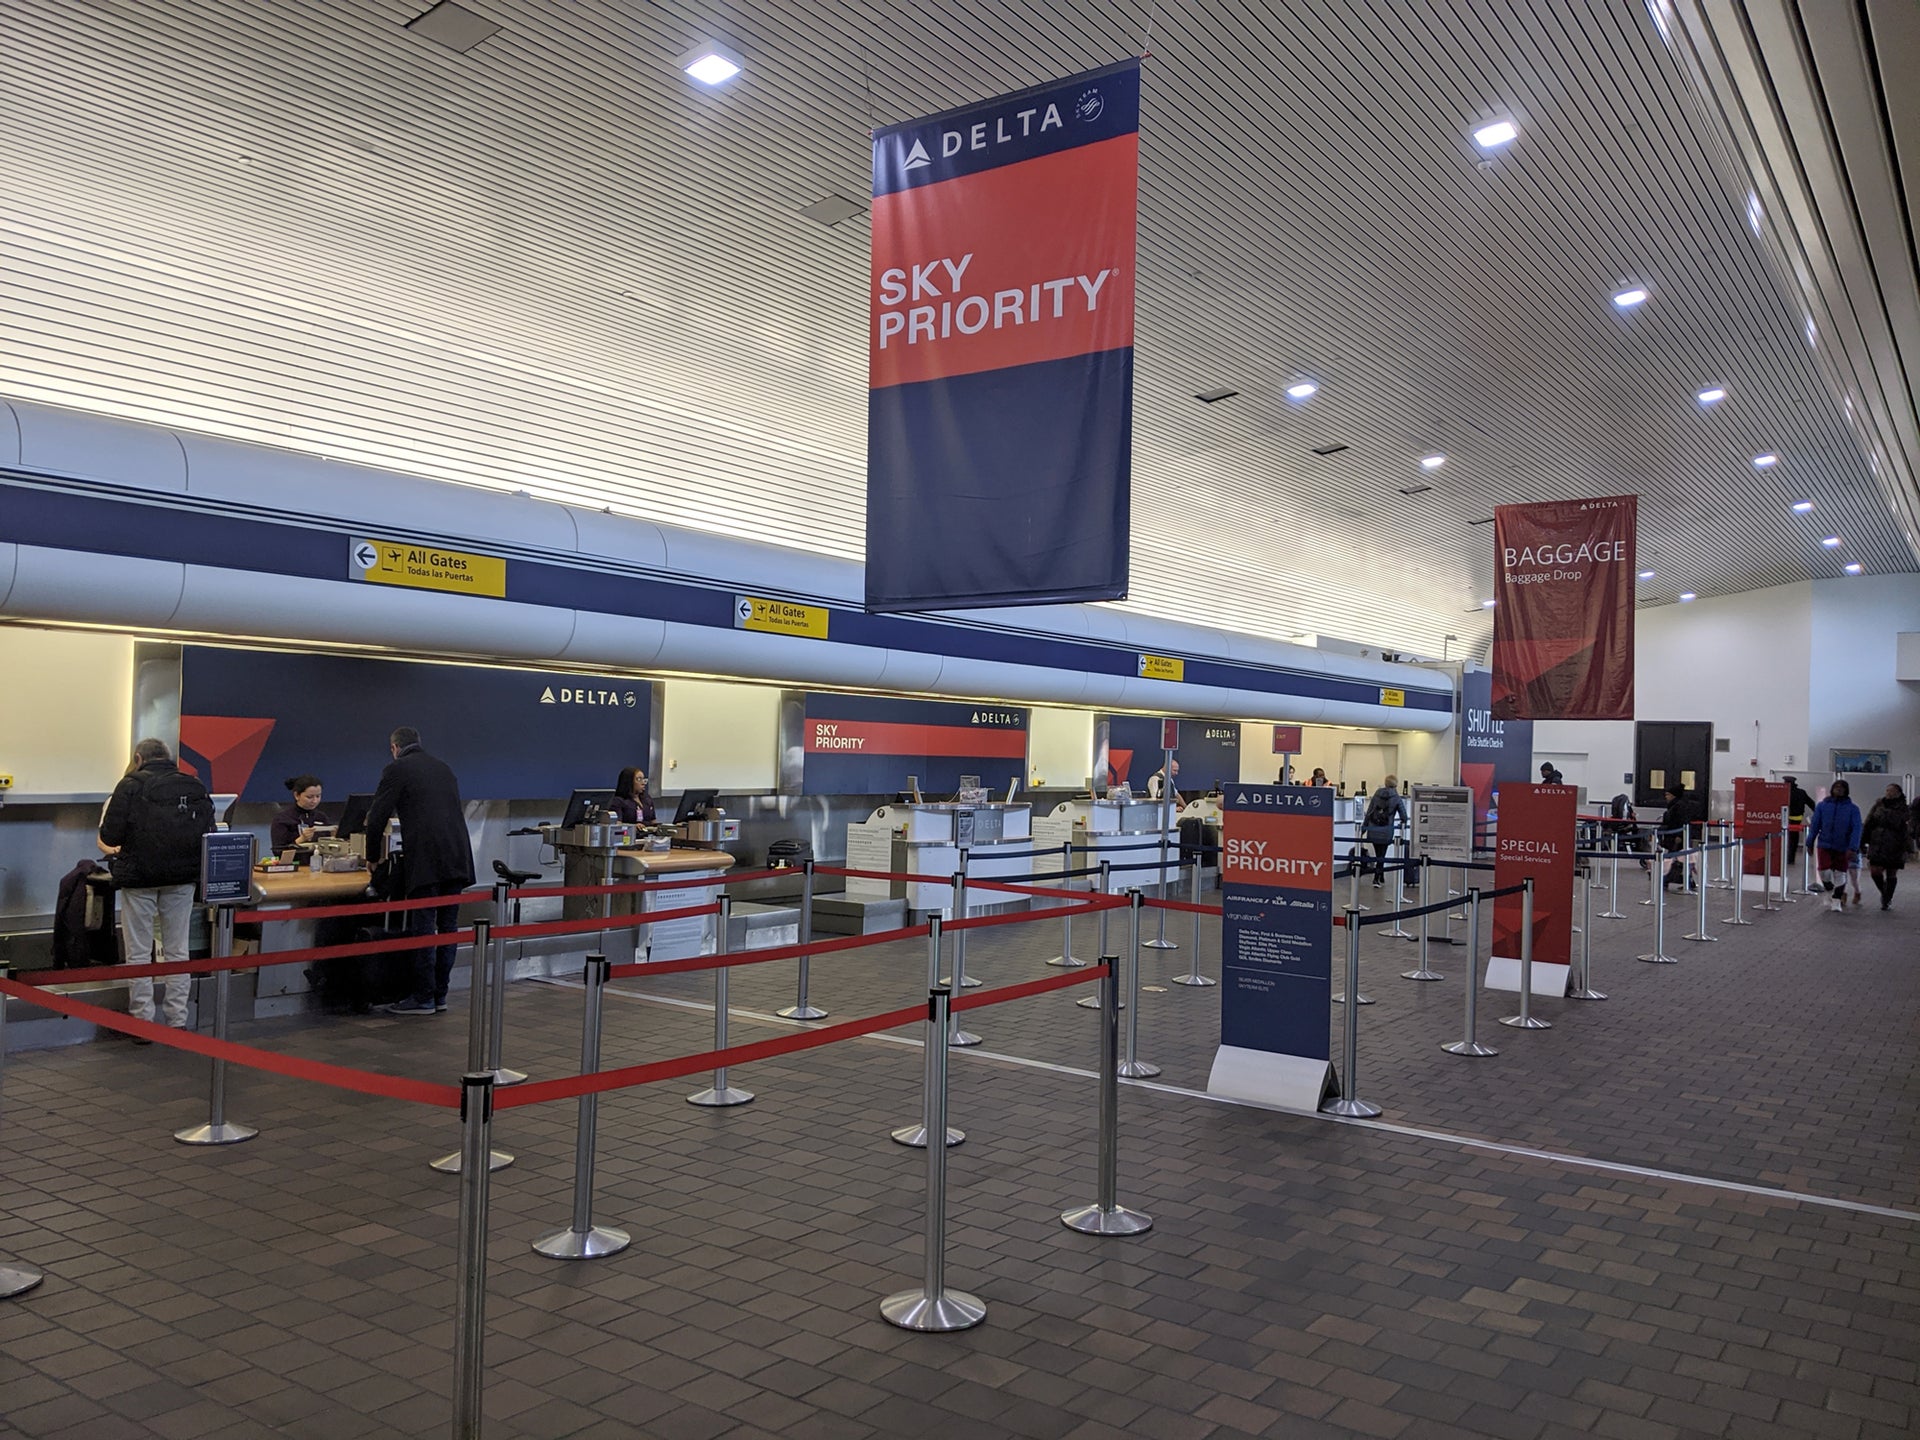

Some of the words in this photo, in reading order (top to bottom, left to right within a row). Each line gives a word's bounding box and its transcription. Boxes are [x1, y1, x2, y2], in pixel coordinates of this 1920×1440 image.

[942, 103, 1064, 158] DELTA
[879, 253, 974, 307] SKY
[879, 270, 1111, 350] PRIORITY
[1589, 501, 1618, 509] DELTA
[407, 550, 426, 564] All
[430, 553, 467, 570] Gates
[1504, 541, 1626, 567] BAGGAGE
[407, 566, 430, 578] Todas
[432, 569, 443, 579] las
[444, 571, 474, 583] Puertas
[1505, 572, 1551, 584] Baggage
[1553, 569, 1582, 581] Drop
[769, 604, 780, 615] All
[782, 606, 805, 619] Gates
[769, 616, 783, 625] Todas
[783, 618, 791, 626] las
[791, 620, 809, 628] Puertas
[561, 688, 619, 706] DELTA
[981, 712, 1011, 725] DELTA
[816, 724, 838, 736] SKY
[1211, 729, 1231, 739] DELTA
[815, 737, 864, 749] PRIORITY
[1252, 793, 1304, 806] DELTA
[1746, 812, 1782, 820] BAGGAG
[1227, 839, 1268, 855] SKY
[1501, 839, 1559, 854] SPECIAL
[1226, 855, 1324, 876] PRIORITY
[1524, 855, 1552, 864] Services
